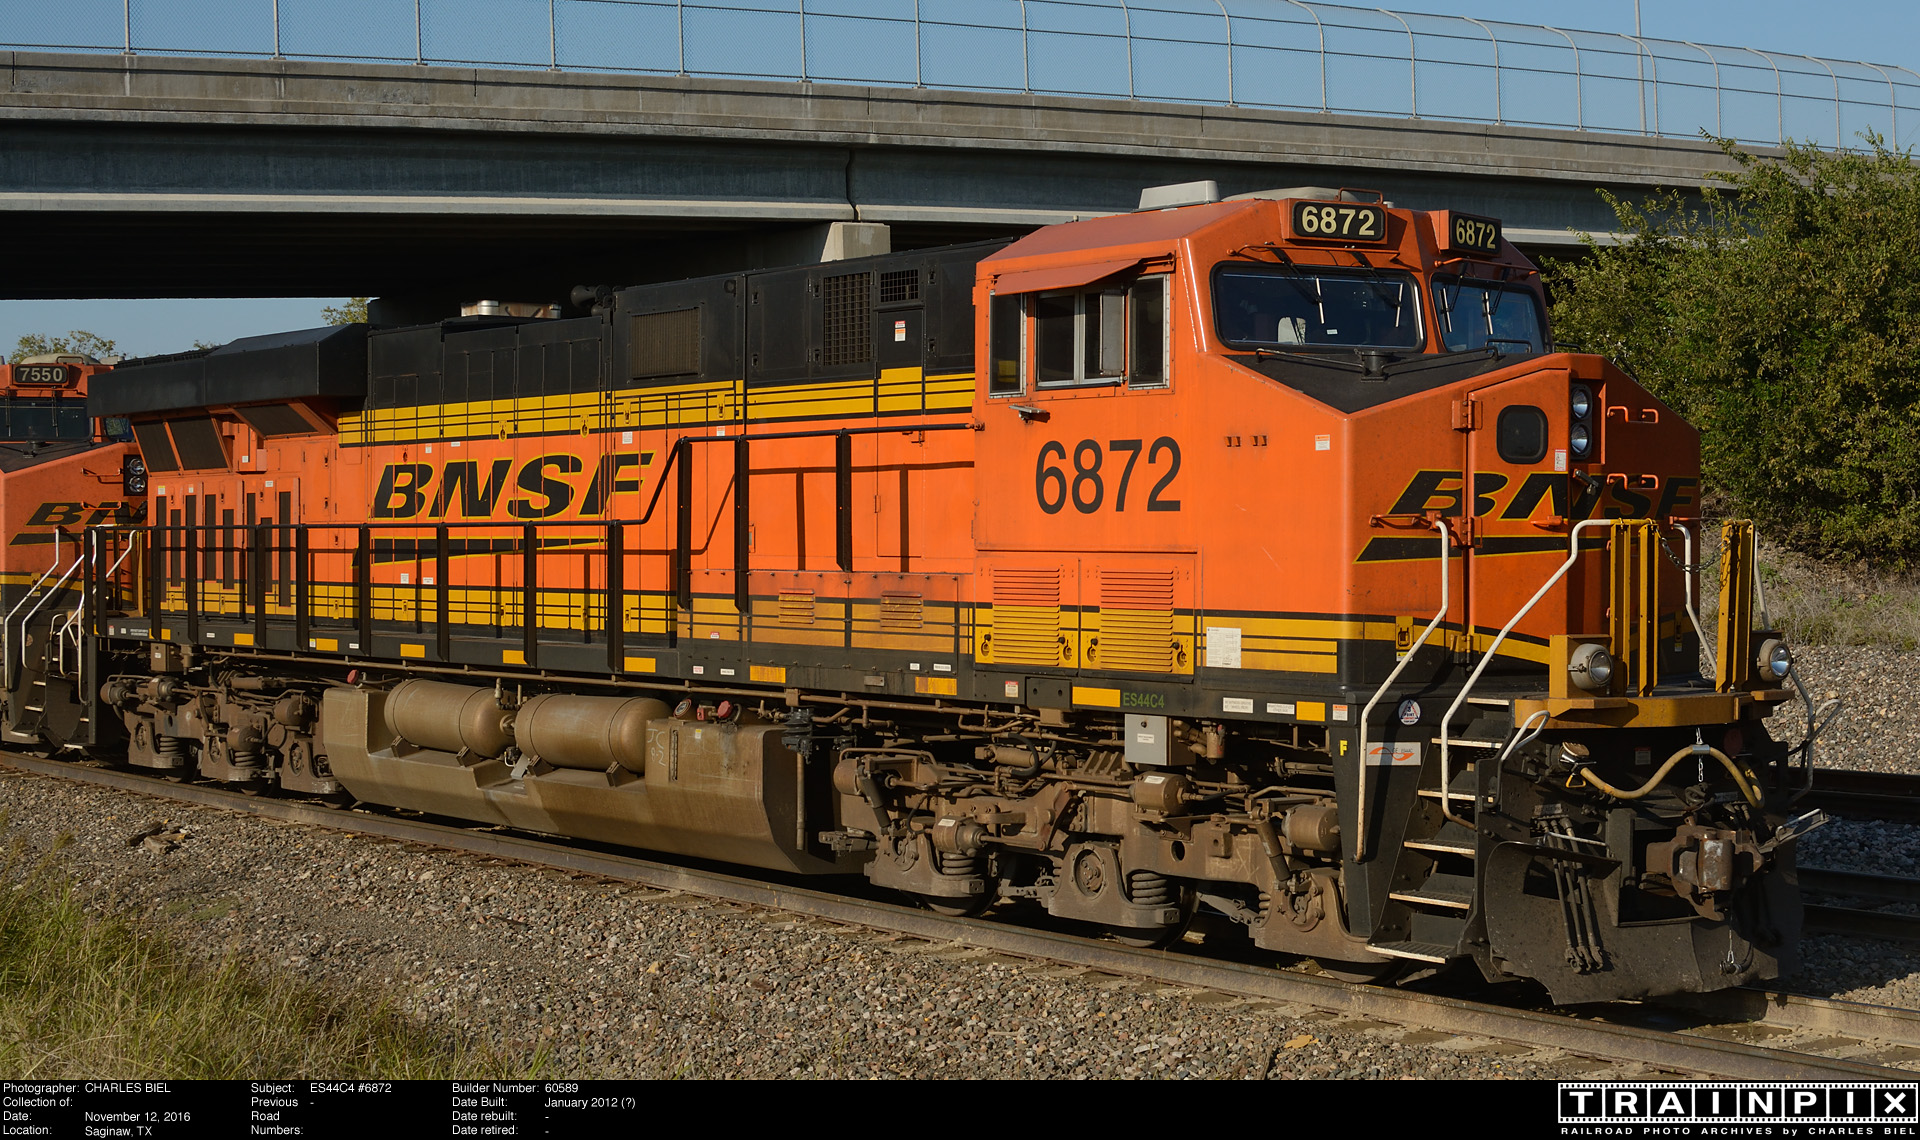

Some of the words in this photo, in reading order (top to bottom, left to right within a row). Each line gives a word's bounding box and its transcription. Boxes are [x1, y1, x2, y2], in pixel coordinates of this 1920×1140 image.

[1302, 205, 1375, 236] 6872
[1455, 218, 1496, 250] 6872
[20, 367, 64, 381] 7550
[369, 450, 657, 520] BNSF
[1035, 436, 1182, 514] 6872
[1386, 468, 1701, 522] BNSF
[1122, 692, 1165, 709] ES44C4
[1339, 739, 1348, 757] F
